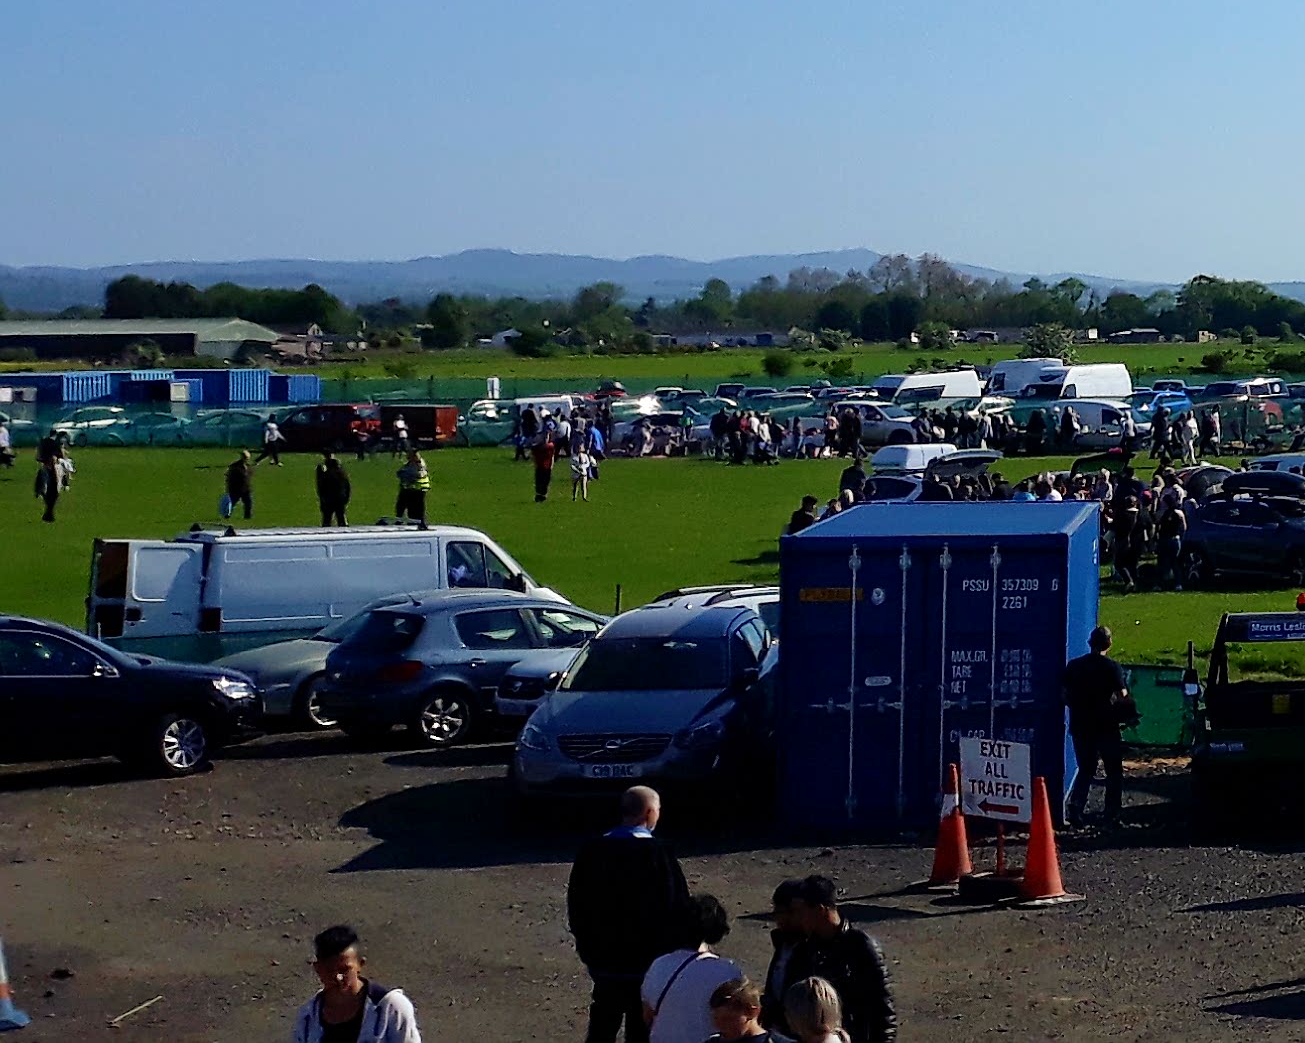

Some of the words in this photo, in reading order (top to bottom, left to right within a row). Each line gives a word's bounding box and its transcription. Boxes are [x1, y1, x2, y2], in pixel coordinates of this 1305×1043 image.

[963, 579, 990, 591] PSSU
[1001, 578, 1039, 591] 357309
[1002, 596, 1028, 609] 2261
[1251, 623, 1281, 632] Morris
[980, 741, 1011, 759] EXIT
[985, 761, 1008, 778] ALL
[969, 779, 1025, 800] TRAFFIC
